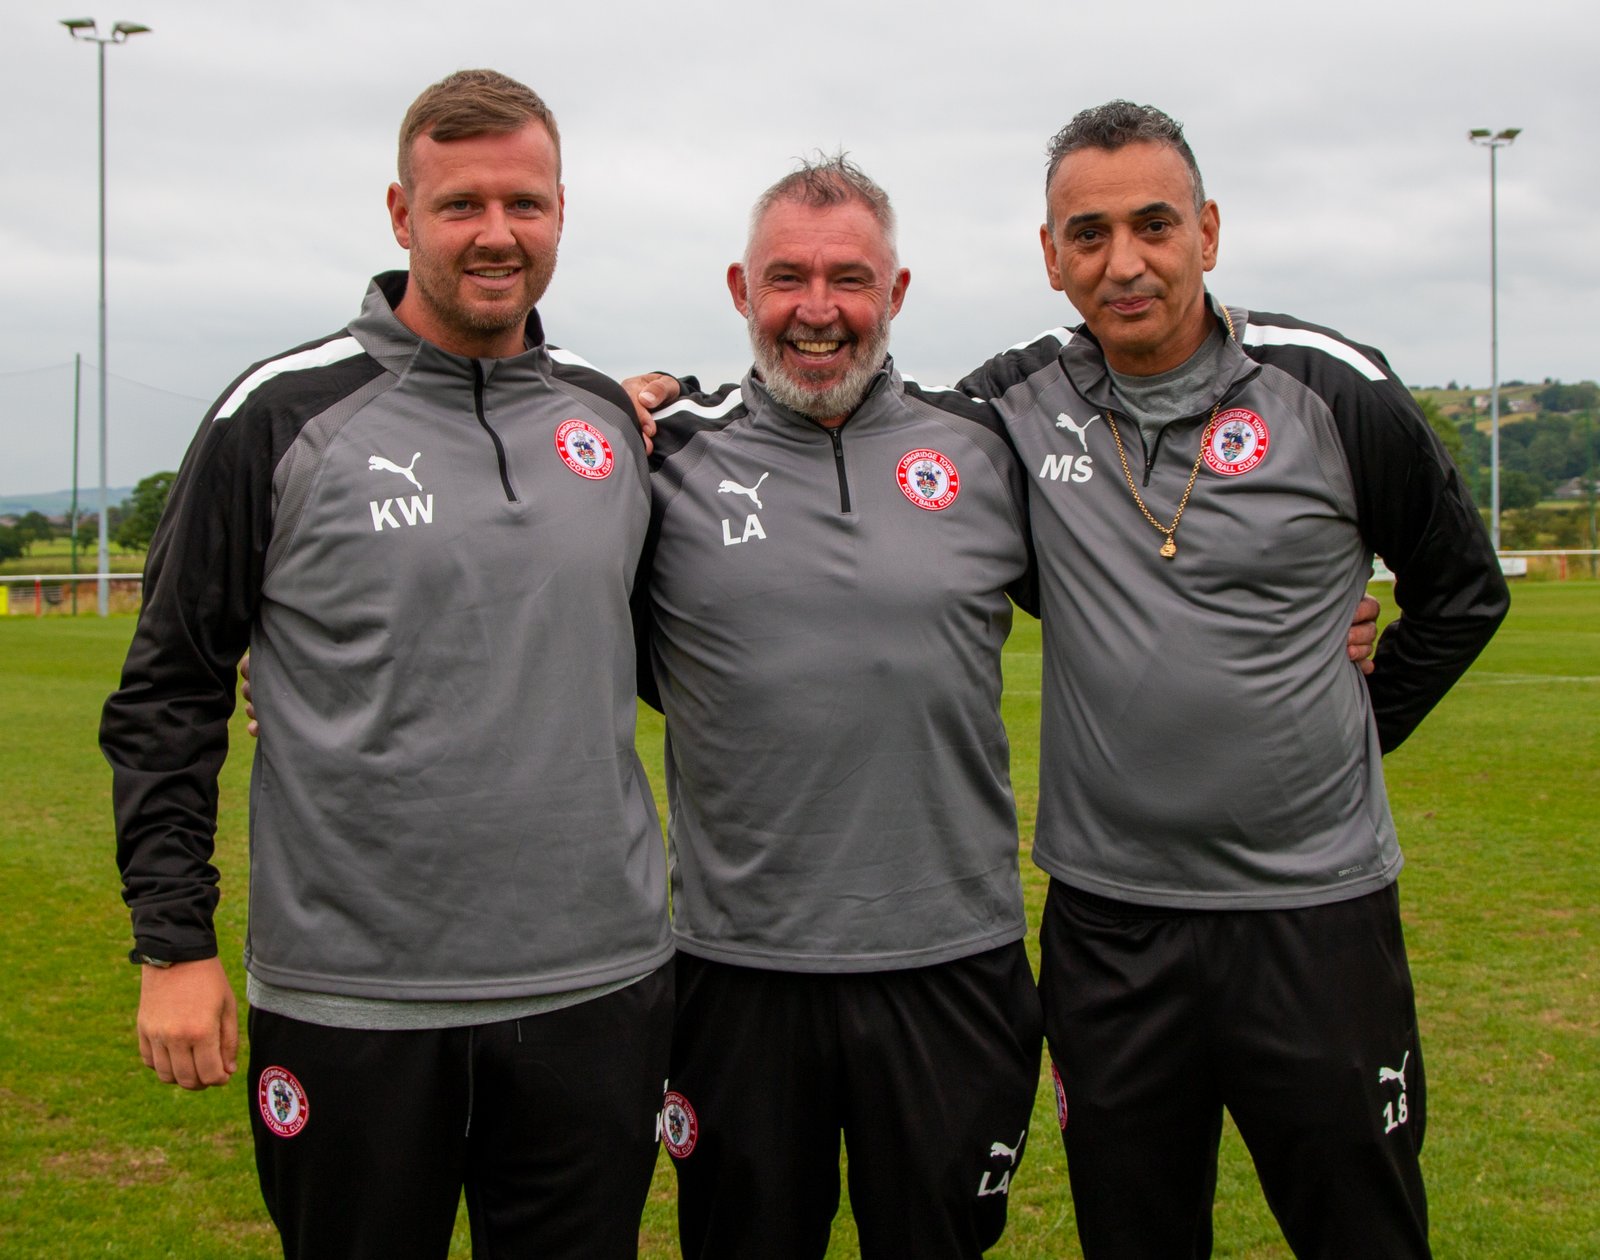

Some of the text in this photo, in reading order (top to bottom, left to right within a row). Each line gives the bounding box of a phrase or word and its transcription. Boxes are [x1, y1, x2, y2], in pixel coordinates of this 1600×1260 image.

[1252, 418, 1266, 440] TOWN
[566, 457, 605, 477] FOOTBALL
[901, 451, 955, 477] LONGRIDGE TOWN
[1039, 454, 1093, 483] MS
[1203, 445, 1259, 472] FOOTBALL CLUB
[902, 483, 955, 508] FOOTBALL CLUB
[369, 494, 433, 531] KW
[721, 513, 767, 546] LA
[1383, 1092, 1408, 1134] 18
[977, 1170, 1010, 1196] LA
